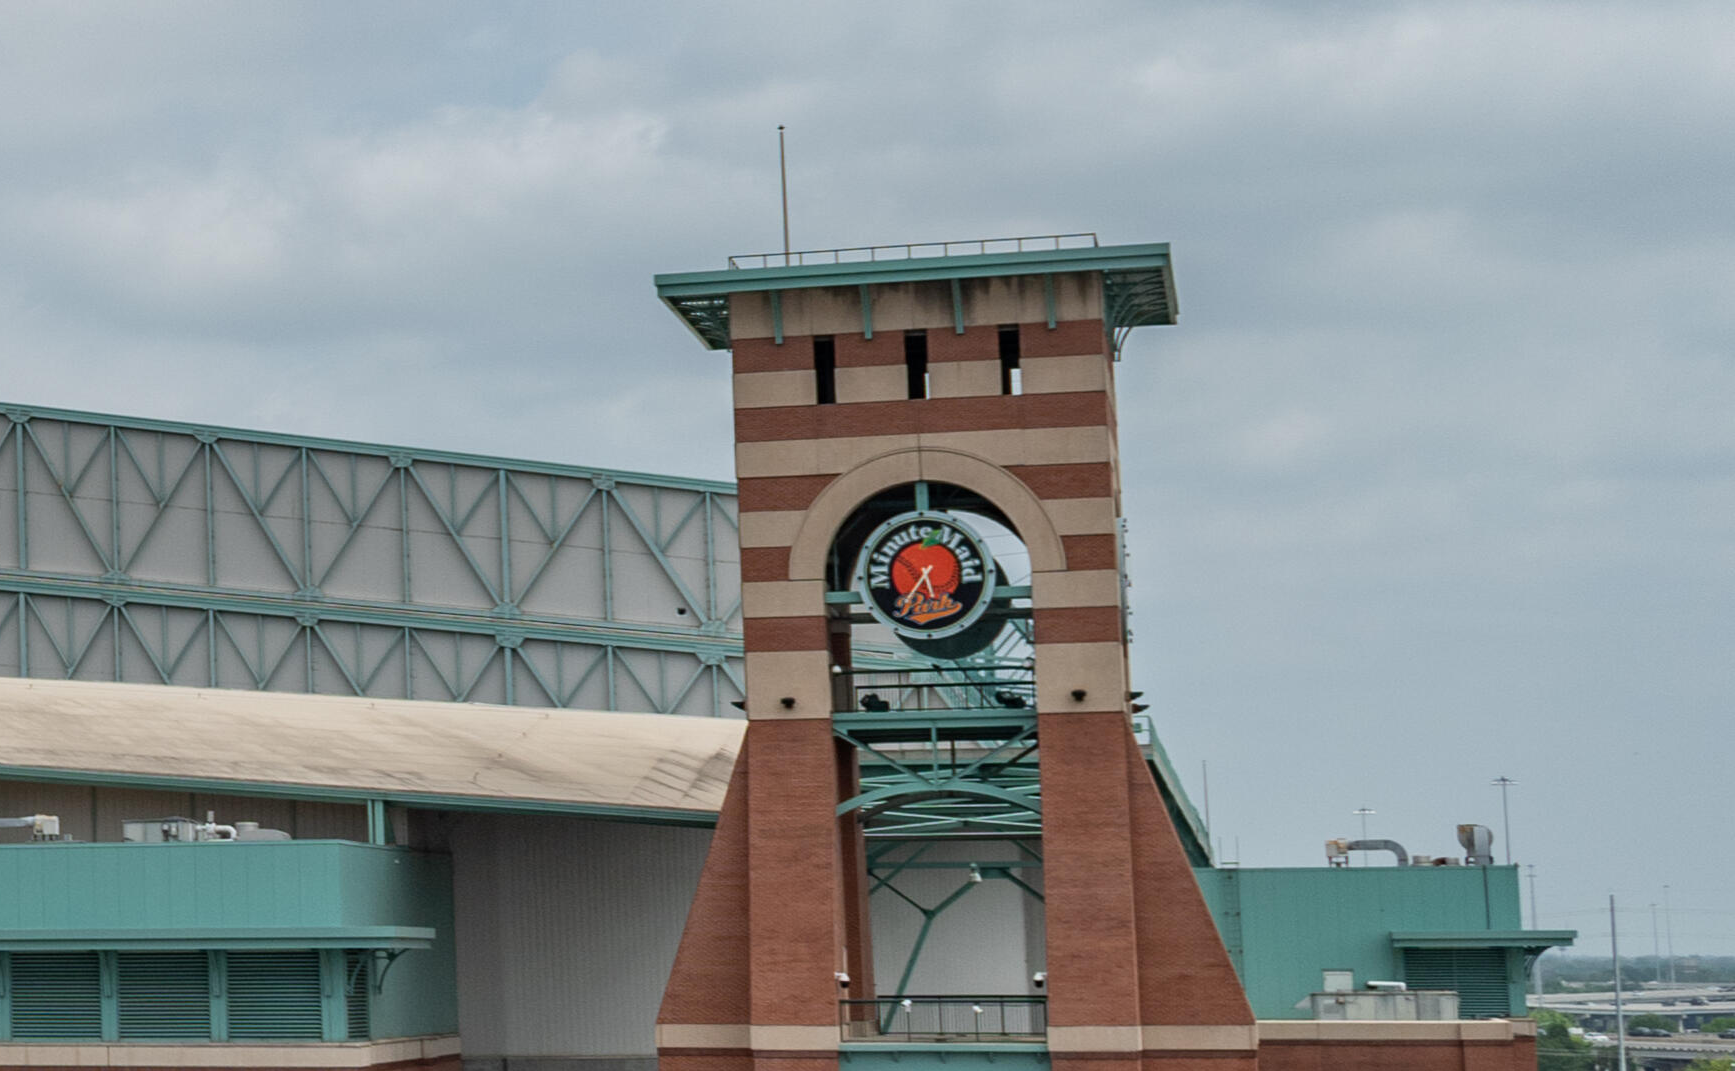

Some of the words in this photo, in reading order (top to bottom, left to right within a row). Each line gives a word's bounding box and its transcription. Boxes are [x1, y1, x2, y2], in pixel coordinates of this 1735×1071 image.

[870, 523, 934, 590] Minute
[935, 524, 983, 584] Maid
[893, 592, 963, 624] Park
